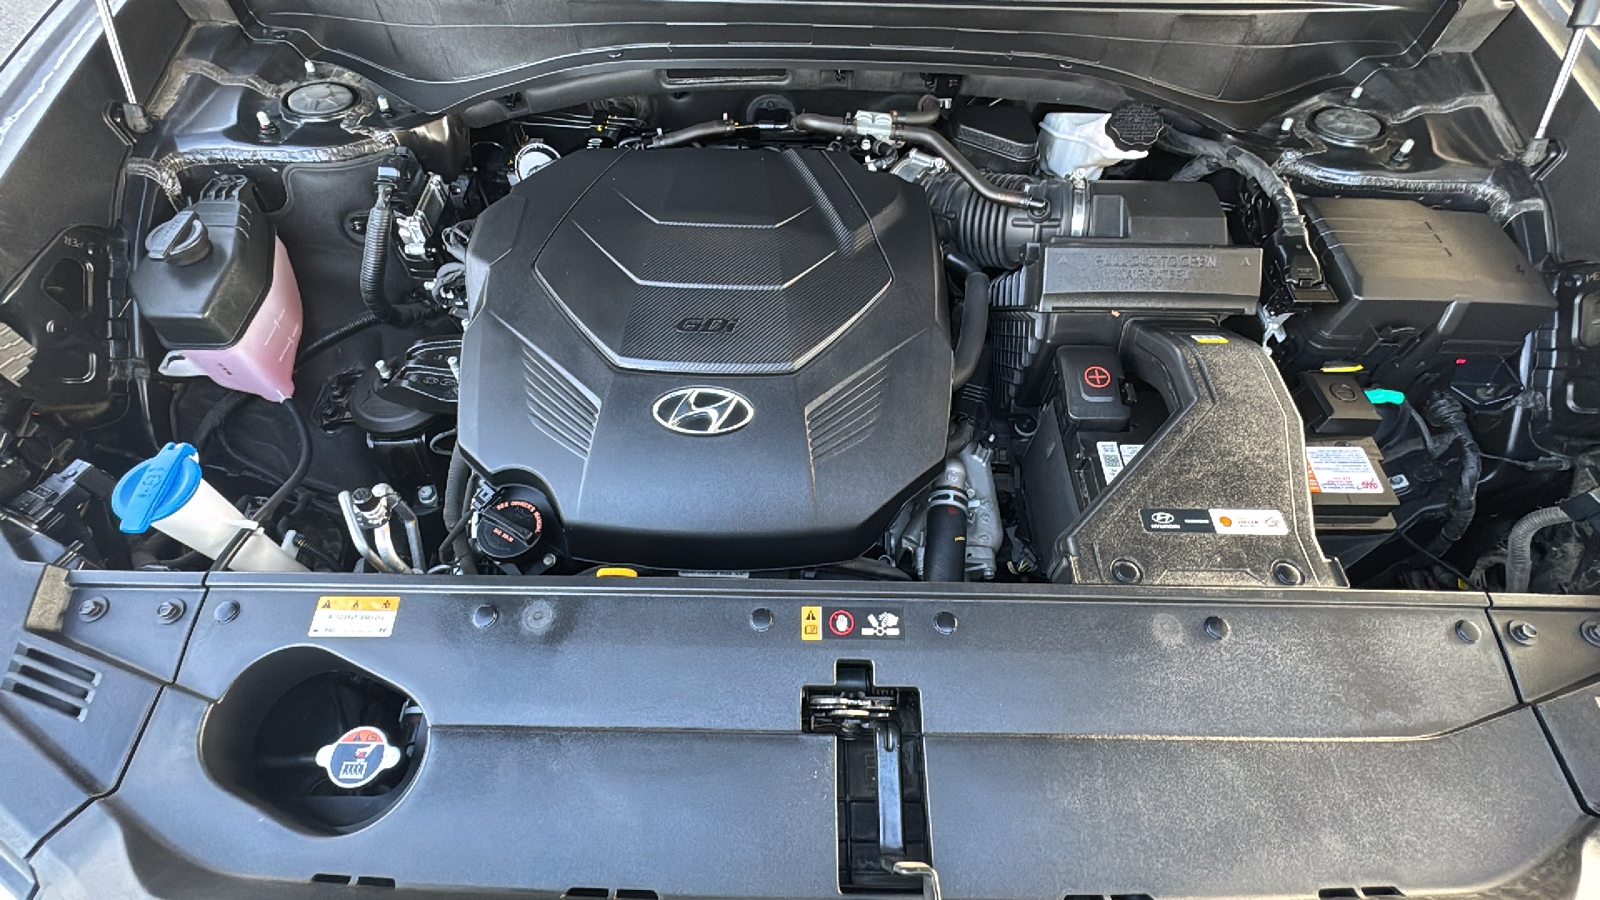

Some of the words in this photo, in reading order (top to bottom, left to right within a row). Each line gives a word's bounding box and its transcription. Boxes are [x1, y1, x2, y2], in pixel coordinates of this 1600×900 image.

[1161, 255, 1177, 267] TO
[1181, 255, 1216, 268] OPEN
[676, 318, 741, 334] GDi
